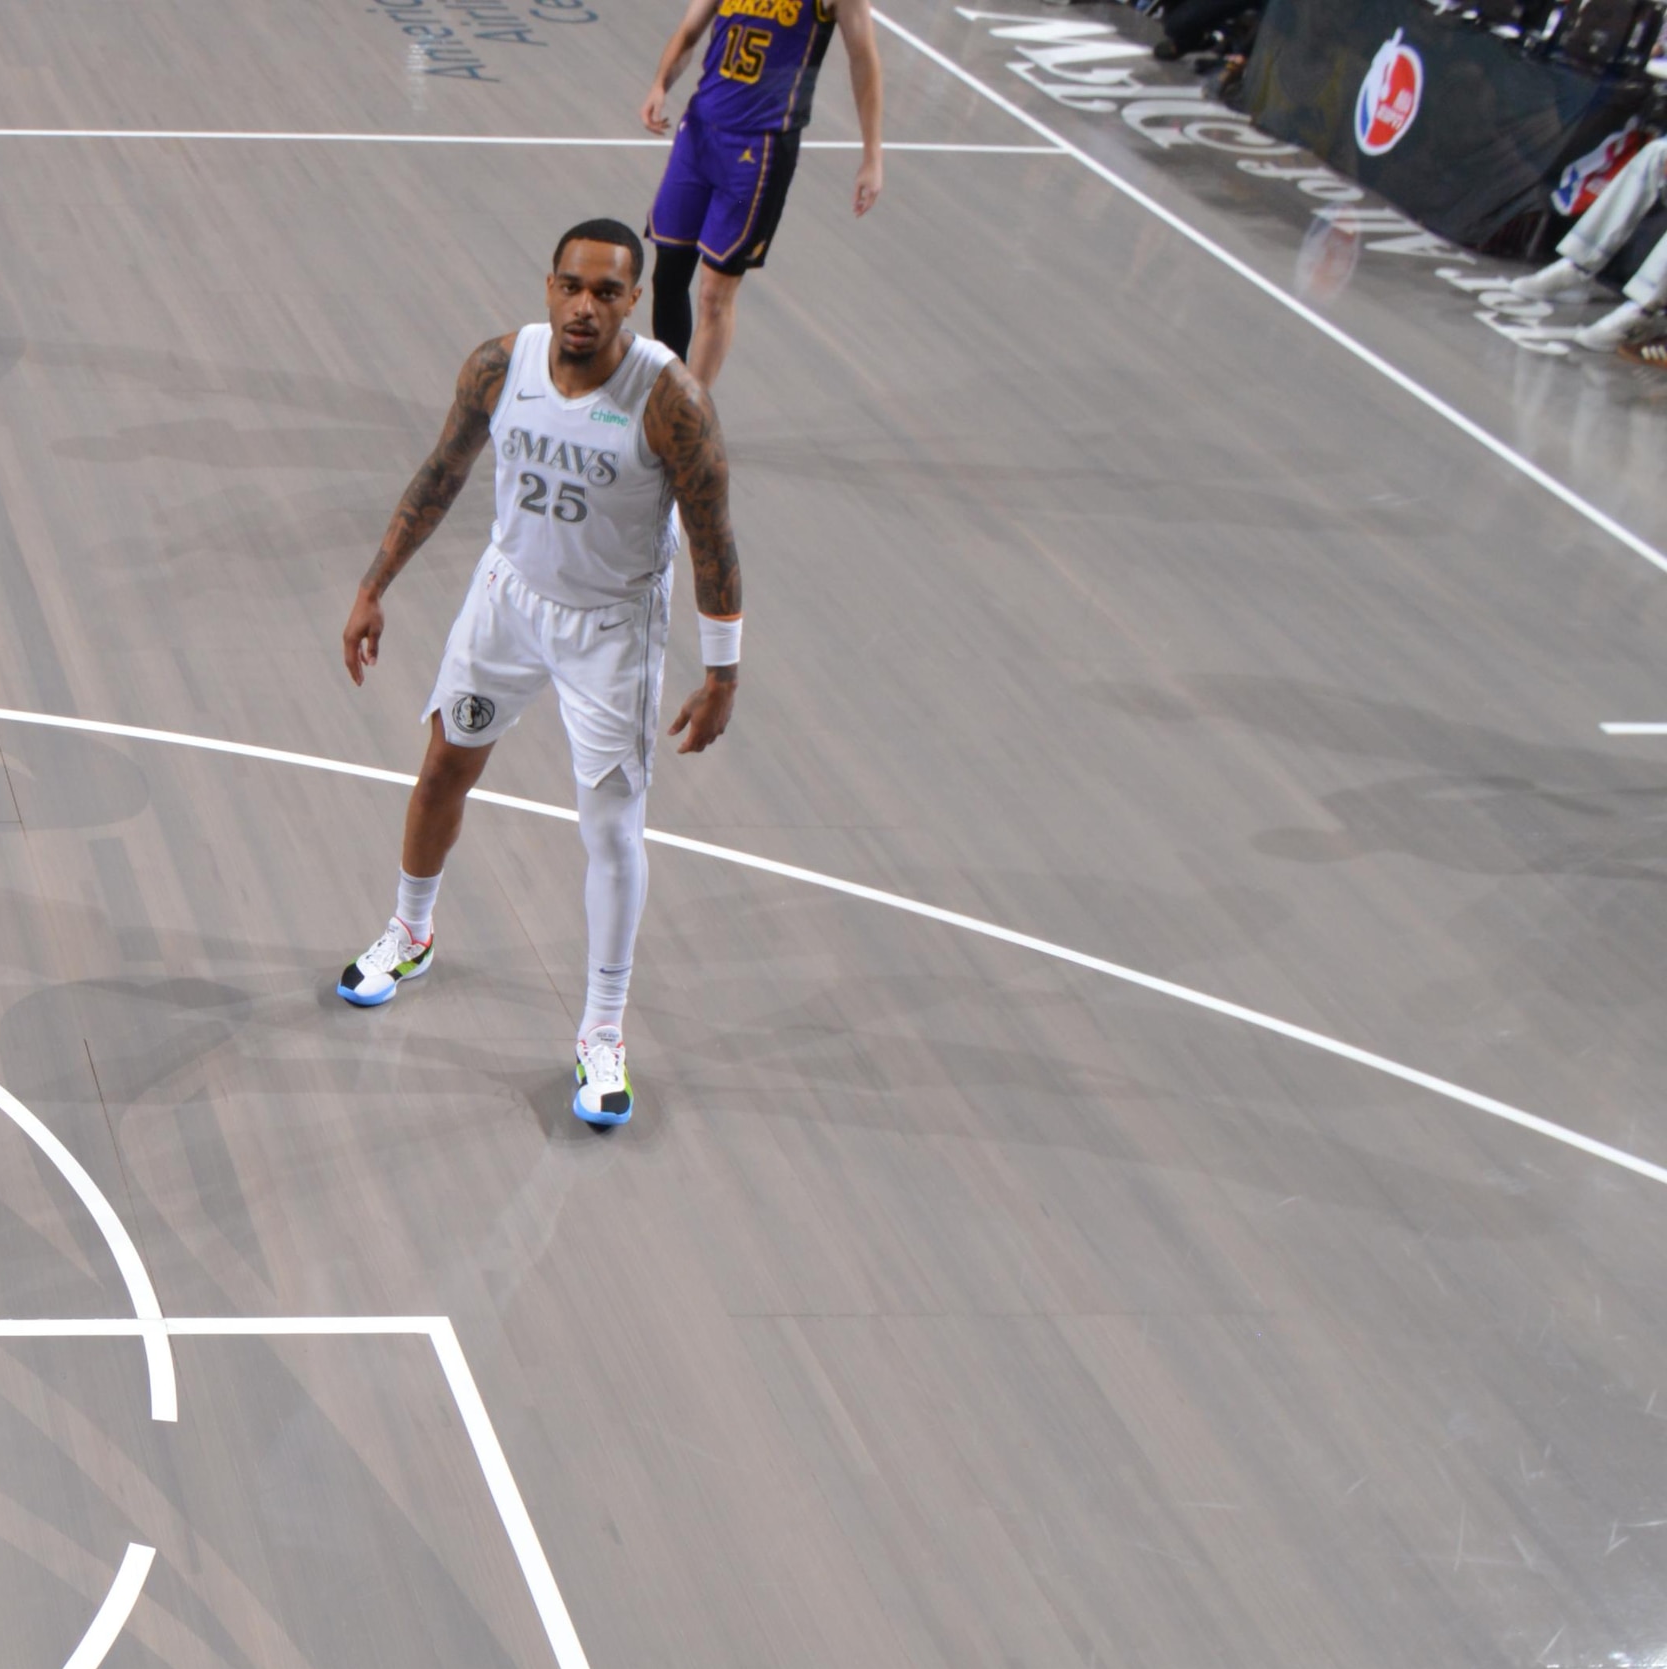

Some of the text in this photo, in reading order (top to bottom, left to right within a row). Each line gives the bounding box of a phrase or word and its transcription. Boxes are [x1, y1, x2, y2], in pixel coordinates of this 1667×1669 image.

[719, 24, 772, 84] 15
[590, 409, 629, 427] chime
[502, 425, 619, 487] MAVS
[519, 472, 588, 523] 25
